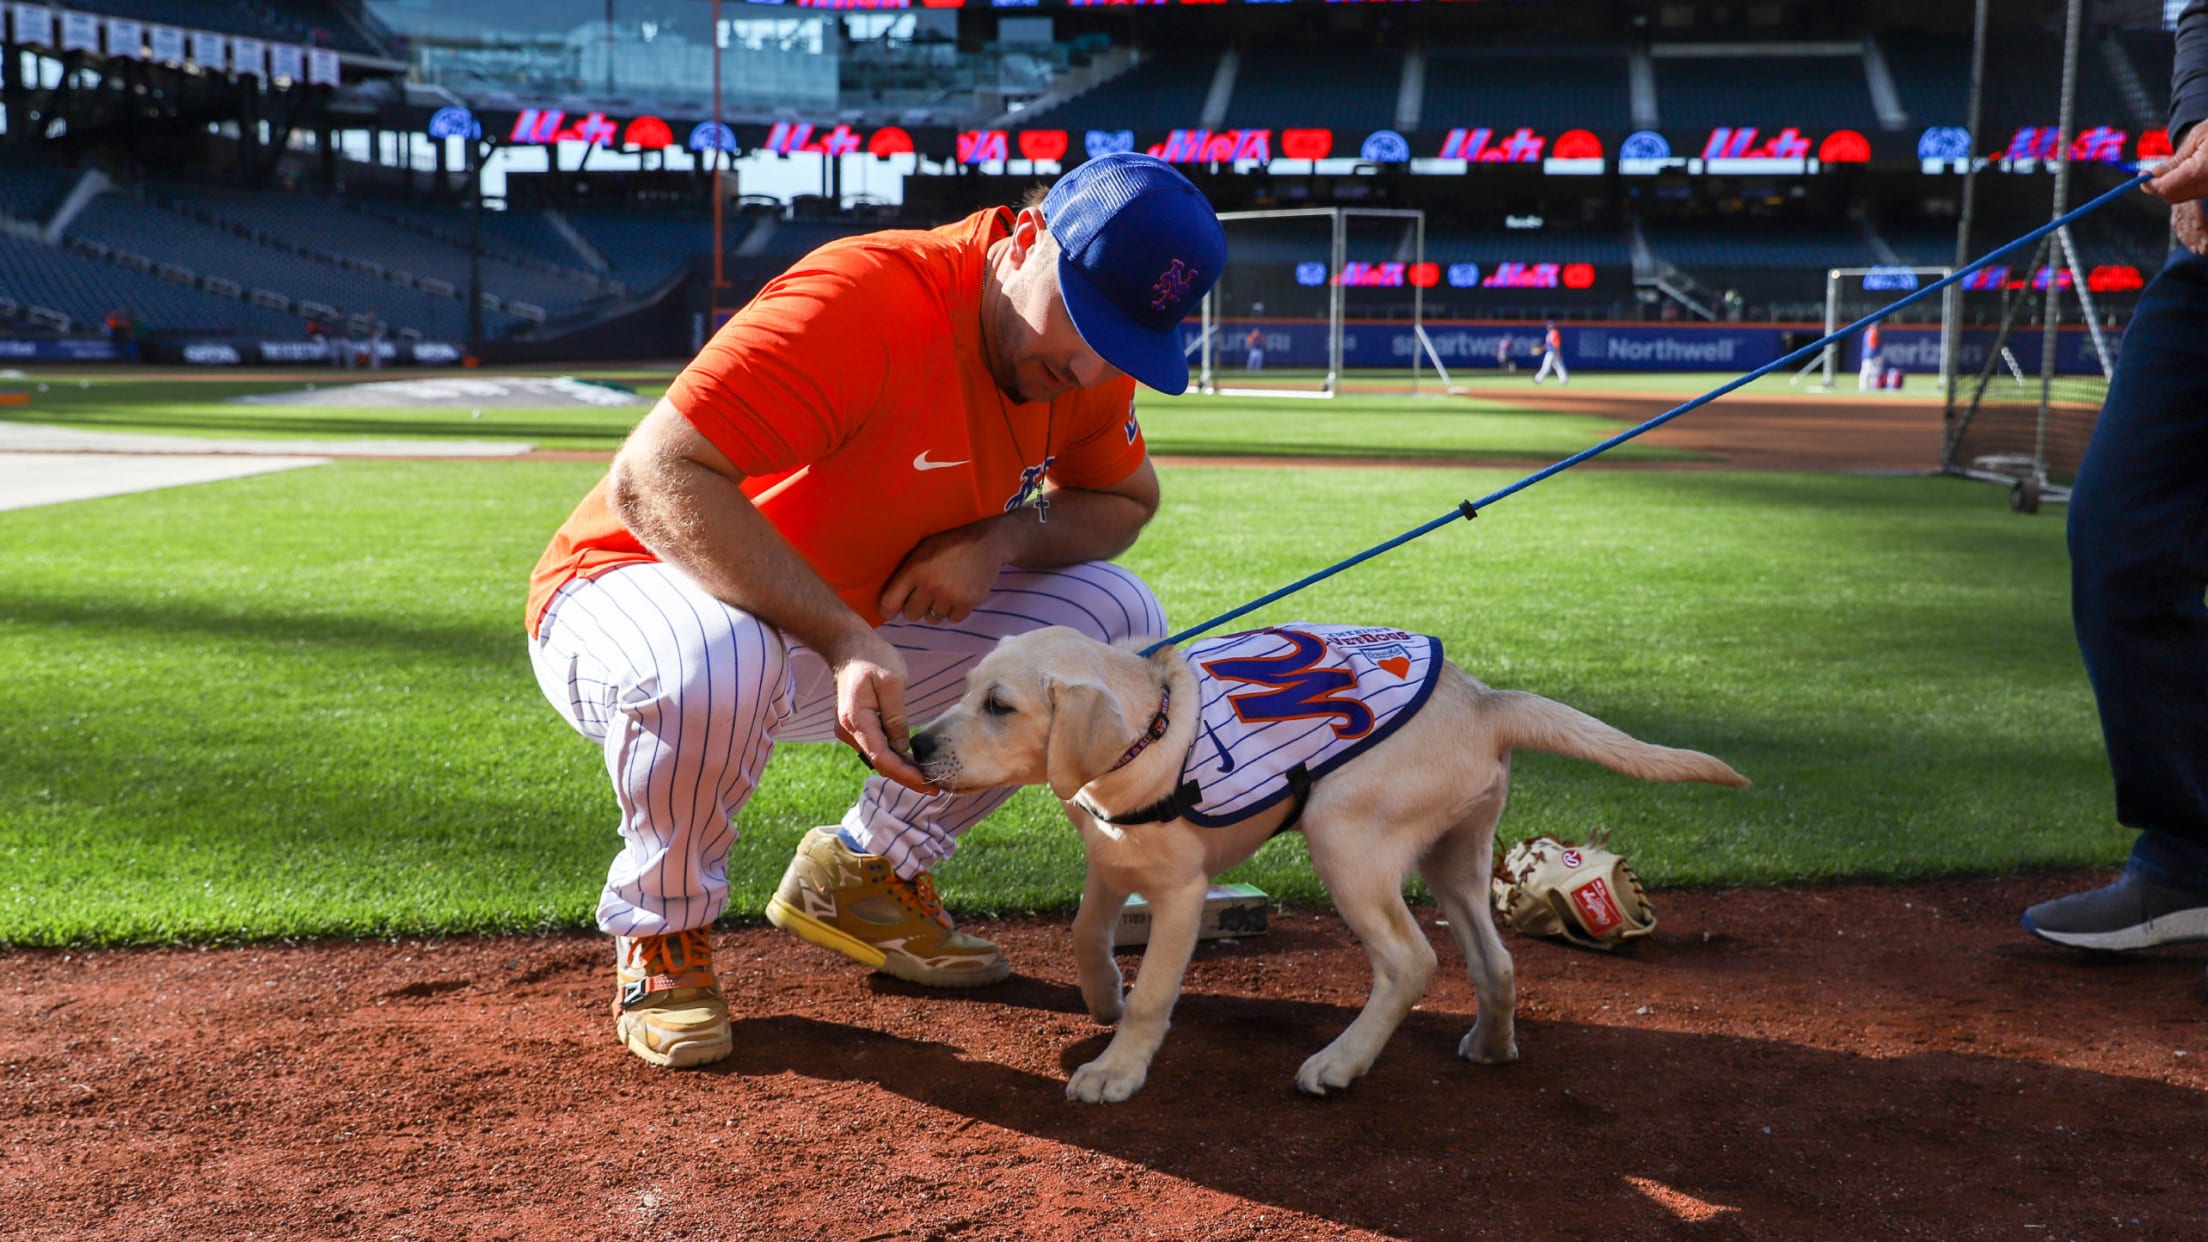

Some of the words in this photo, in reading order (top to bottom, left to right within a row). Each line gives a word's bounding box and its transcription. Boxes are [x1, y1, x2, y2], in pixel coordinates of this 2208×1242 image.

[765, 121, 861, 156] Mts
[1440, 127, 1546, 162] Mts
[1703, 127, 1812, 162] Mts
[1393, 332, 1543, 357] sartwaer
[1607, 337, 1734, 361] Northwell
[1883, 339, 1981, 365] verizn
